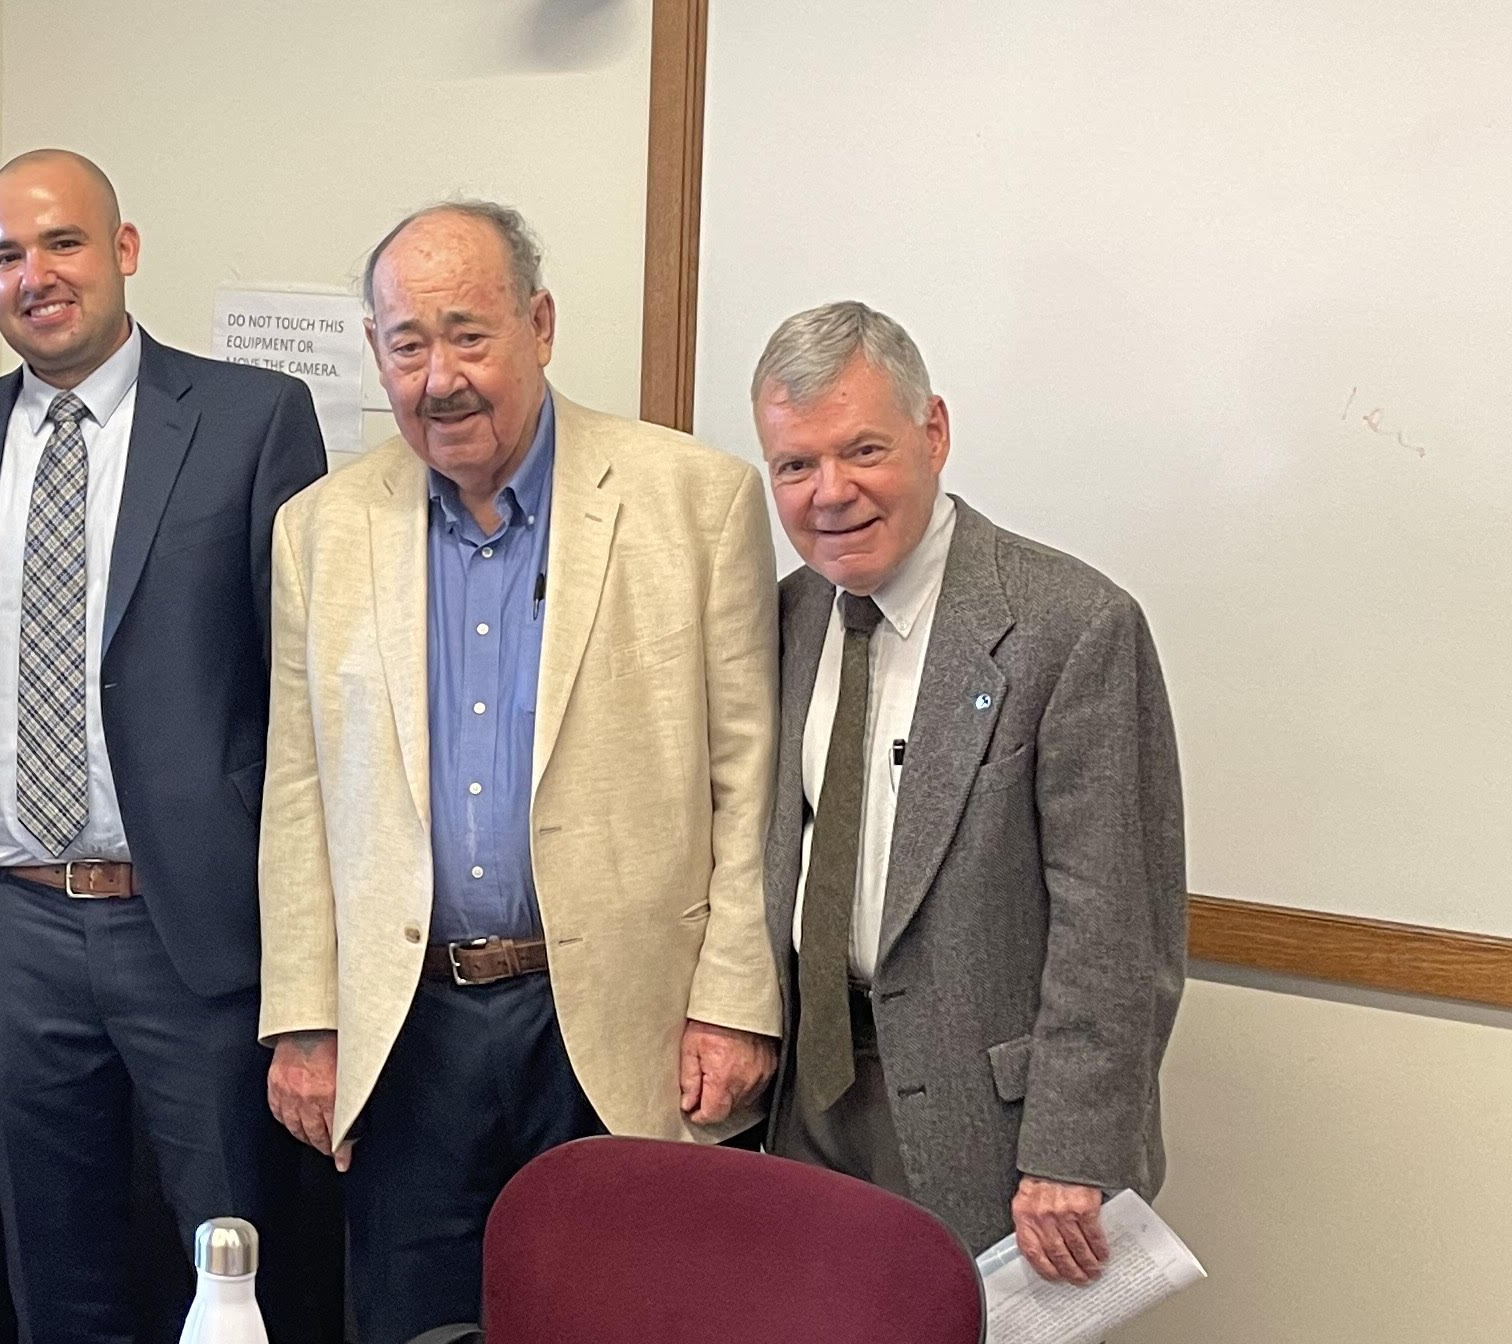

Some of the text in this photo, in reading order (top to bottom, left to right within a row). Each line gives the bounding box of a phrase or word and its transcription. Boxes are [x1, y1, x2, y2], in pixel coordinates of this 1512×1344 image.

[228, 313, 344, 333] DO NOT TOUCH THIS
[226, 335, 314, 354] EQUIPMENT OR
